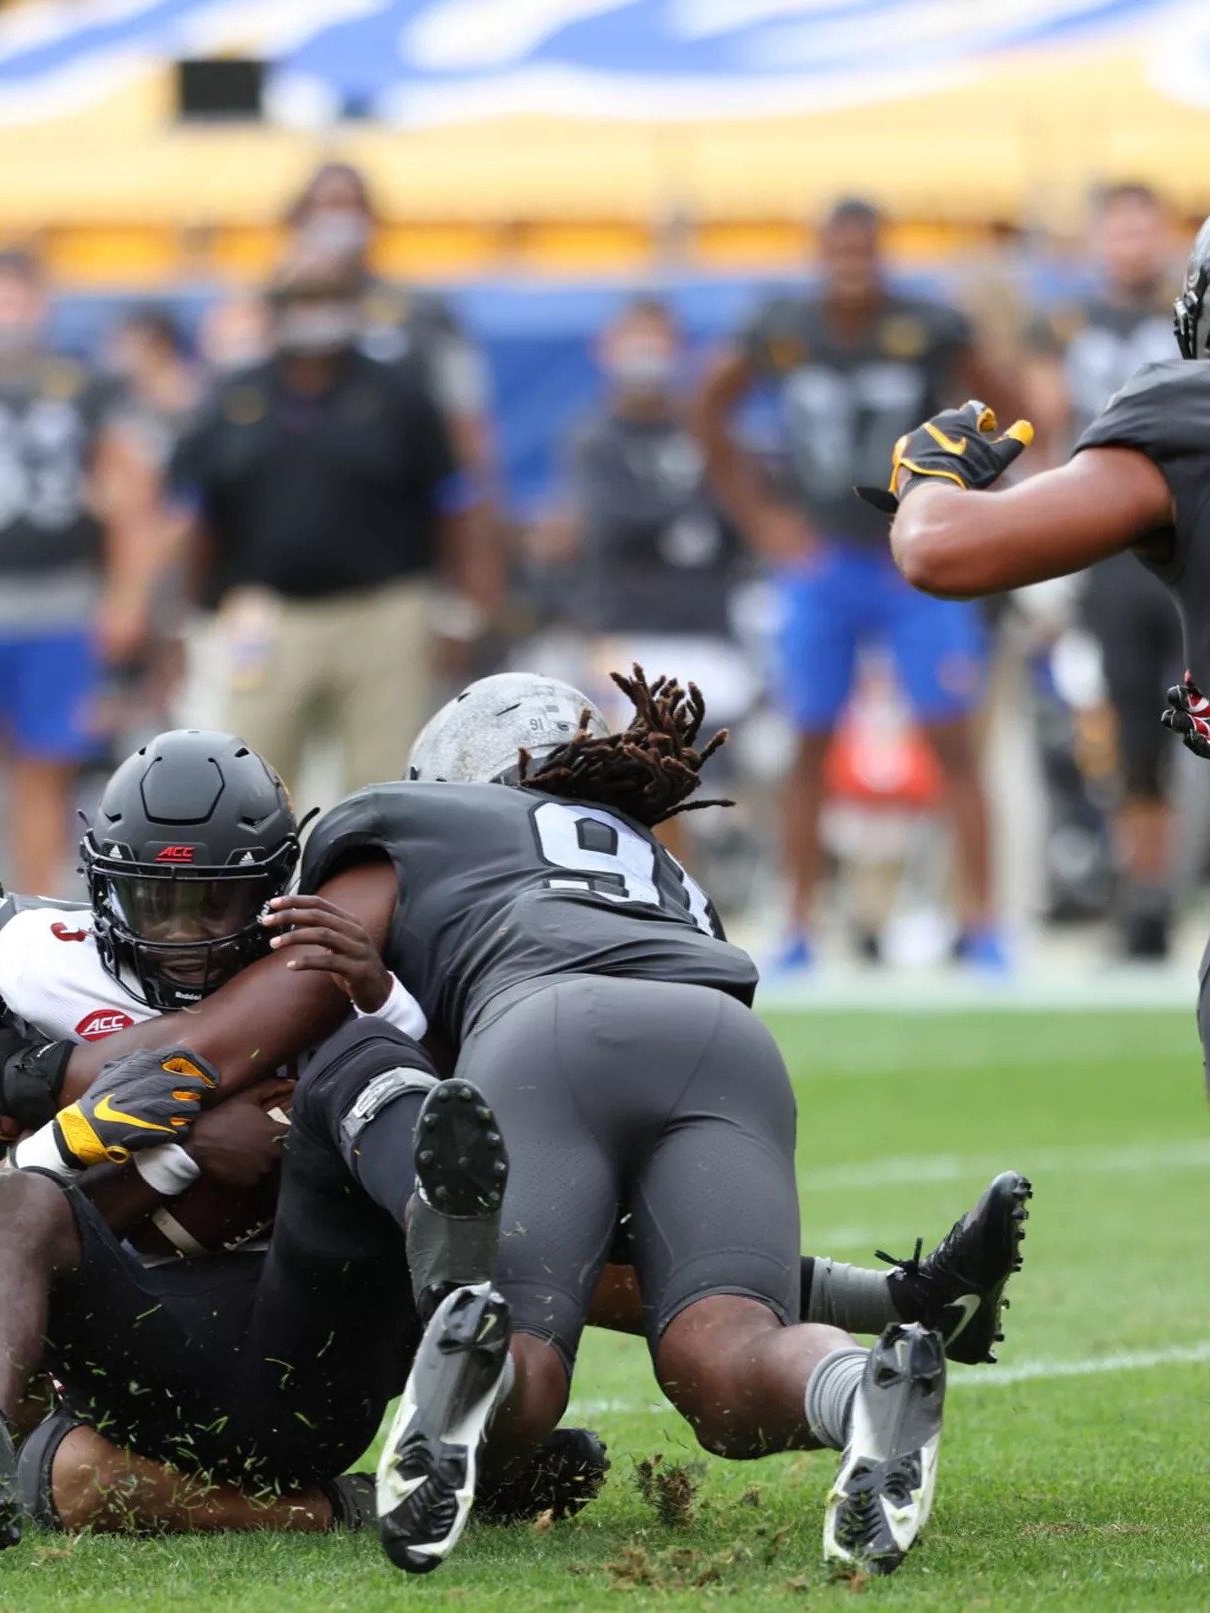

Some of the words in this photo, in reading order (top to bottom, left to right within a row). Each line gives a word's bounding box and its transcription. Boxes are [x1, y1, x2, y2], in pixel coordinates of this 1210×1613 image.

[529, 718, 545, 731] 91
[156, 846, 197, 858] ACC
[82, 1015, 126, 1034] ACC
